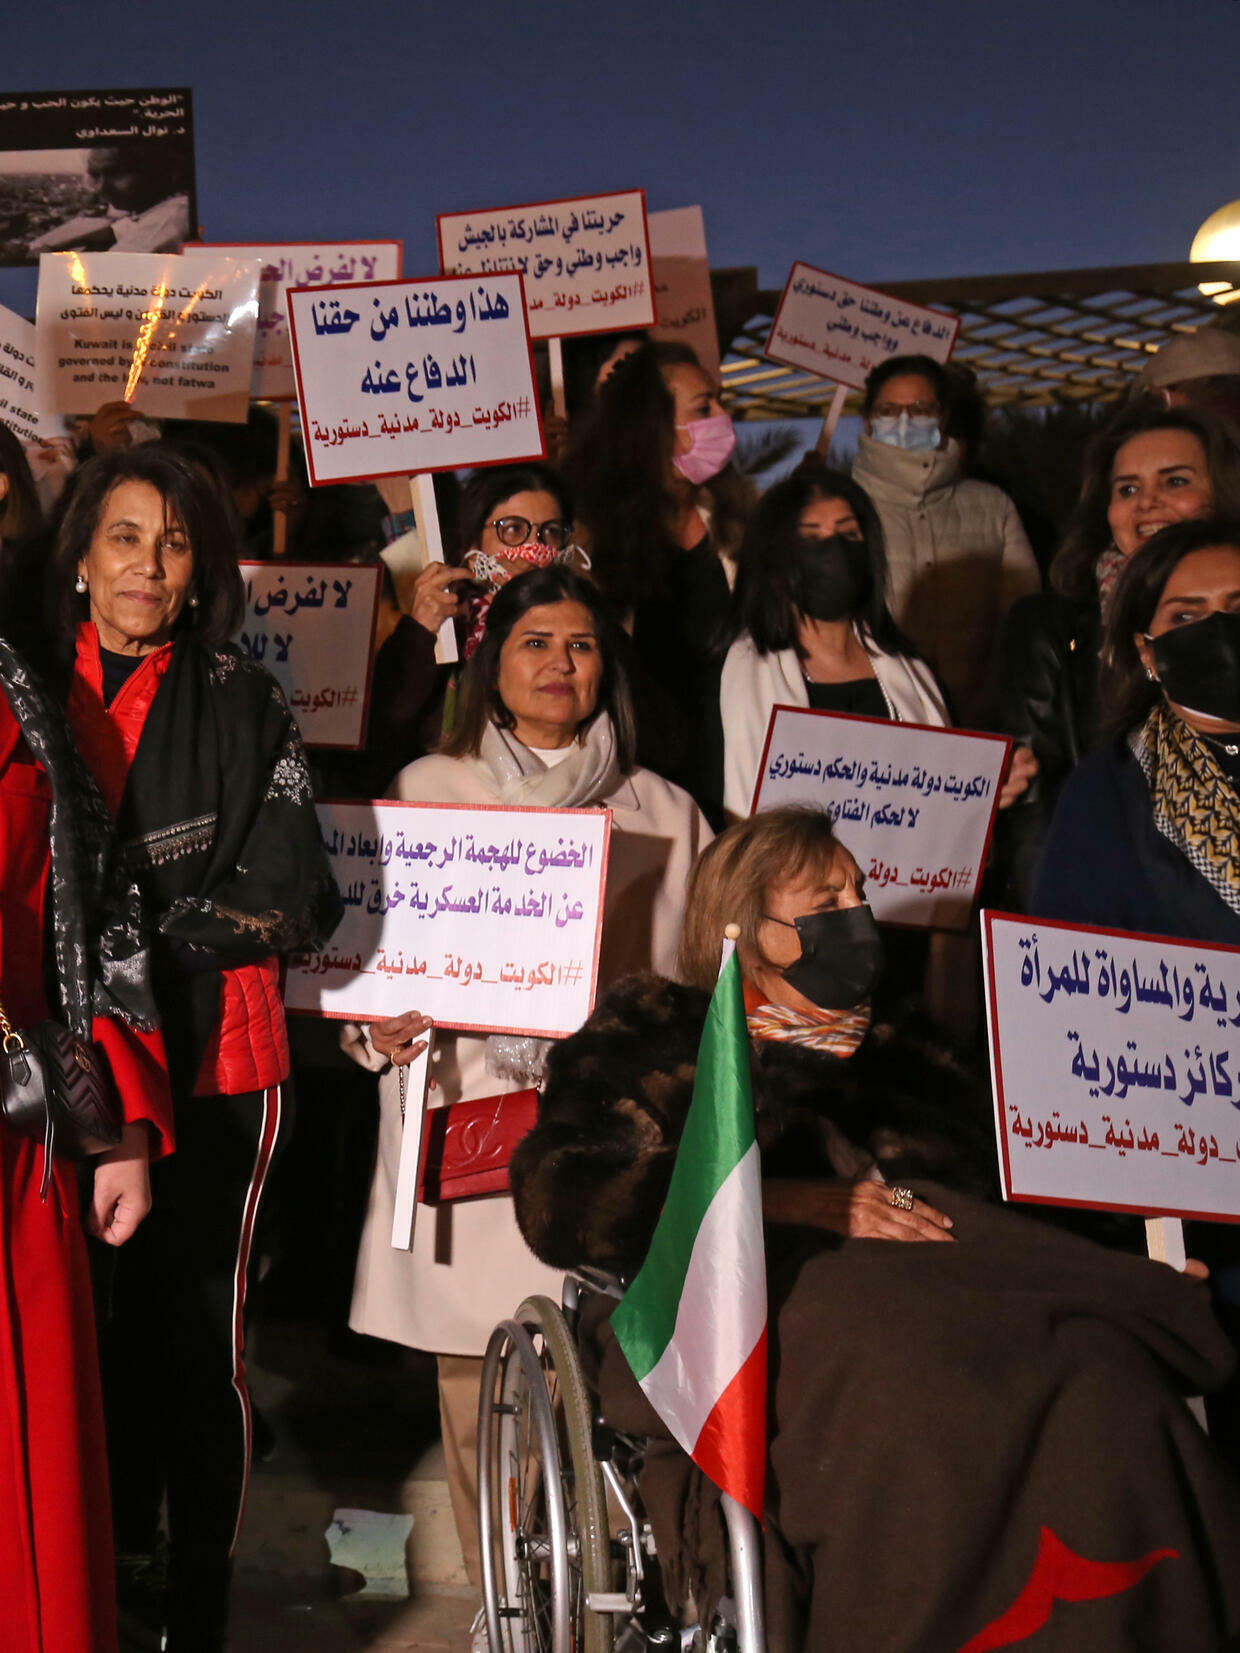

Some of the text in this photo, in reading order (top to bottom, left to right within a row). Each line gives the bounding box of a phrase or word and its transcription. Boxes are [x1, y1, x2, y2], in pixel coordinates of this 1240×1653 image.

[458, 211, 625, 251] حريتنا في المشاركة بالجيش
[533, 254, 563, 279] وحق
[566, 249, 603, 278] وطني
[607, 244, 642, 267] واجب
[116, 285, 148, 298] مدنية
[470, 286, 510, 322] هذا
[100, 308, 124, 321] ليس
[311, 299, 360, 336] حقنا
[370, 297, 400, 342] من
[405, 292, 467, 334] وطننا
[3, 342, 25, 361] دولة
[74, 339, 118, 350] Kuwait
[122, 339, 133, 350] is
[58, 356, 115, 368] governed
[118, 357, 133, 369] by
[361, 353, 476, 403] الدفاع عنه
[73, 373, 95, 383] and
[99, 373, 119, 383] the
[152, 376, 175, 386] not
[178, 377, 216, 389] fatwa
[10, 405, 40, 424] state
[254, 575, 327, 616] لفرض
[333, 579, 352, 608] لا
[273, 632, 293, 662] لا
[290, 685, 359, 713] #الكويت
[768, 753, 991, 802] الكويت دولة مدنية والحكم دستوري
[870, 803, 906, 829] لحكم
[907, 807, 920, 828] لا
[347, 831, 393, 866] وابعاد
[395, 830, 463, 870] الرجعية
[465, 834, 524, 874] للهجمة
[525, 837, 593, 876] الخضوع
[366, 879, 405, 916] خرق
[409, 882, 490, 920] العسكرية
[491, 885, 553, 920] الخدمة
[555, 892, 584, 928] عن
[1019, 933, 1091, 1004] للمرأة
[1096, 949, 1195, 1022] والمساواة
[1066, 1029, 1178, 1099] دستورية
